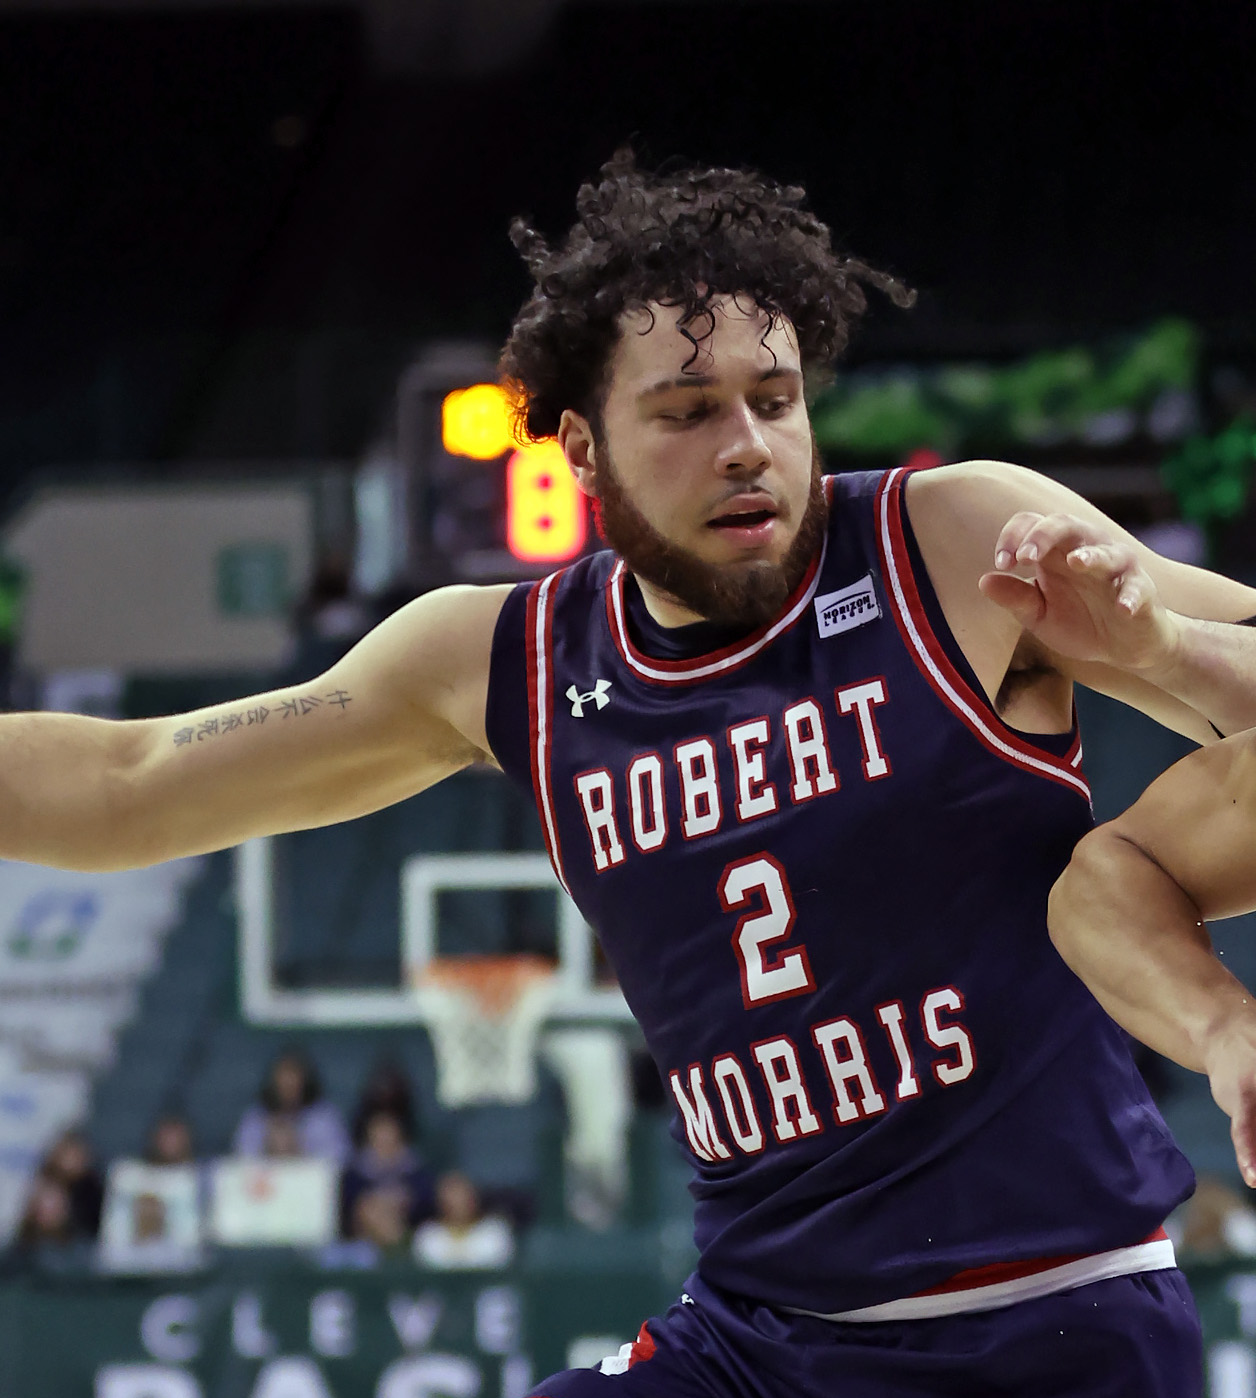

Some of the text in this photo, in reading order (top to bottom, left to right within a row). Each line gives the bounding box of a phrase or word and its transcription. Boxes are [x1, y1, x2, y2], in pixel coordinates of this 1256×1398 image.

[823, 595, 870, 620] HORIZON
[575, 676, 892, 872] ROBERT
[717, 851, 817, 1010] 2
[669, 985, 977, 1162] MORRIS
